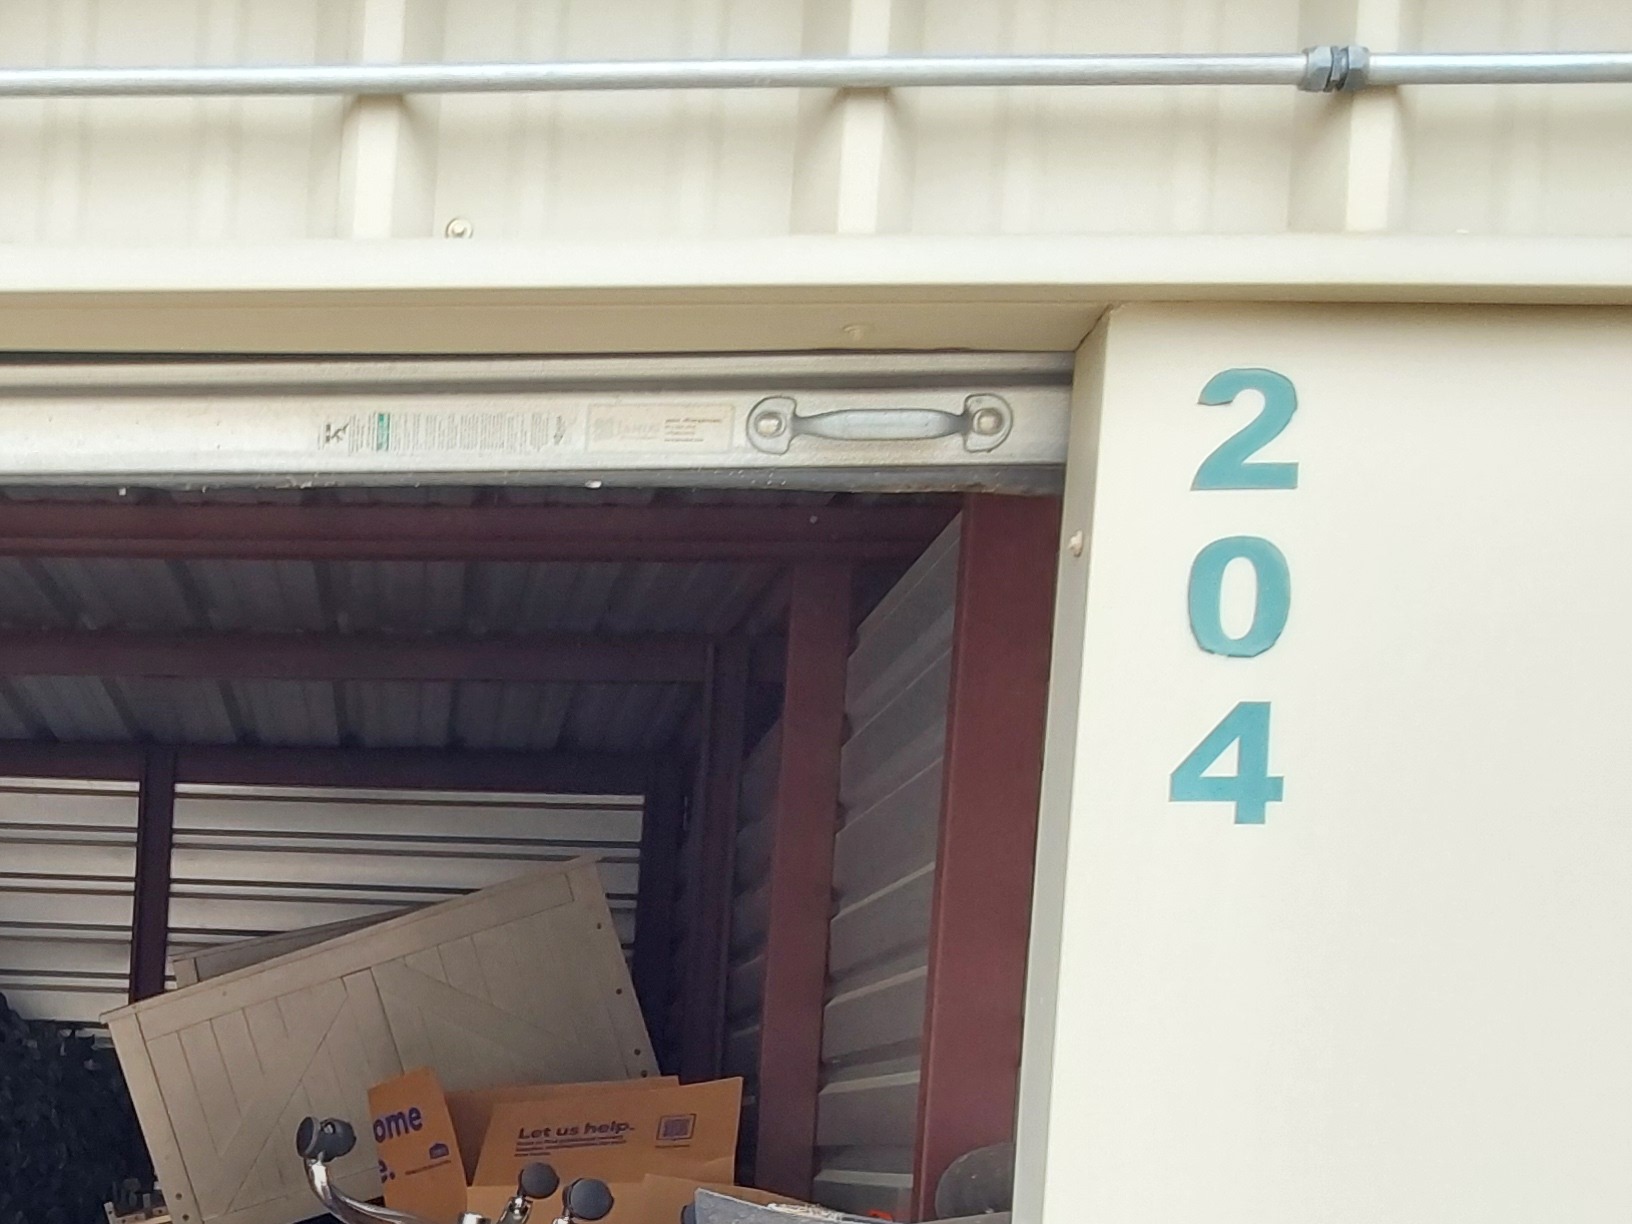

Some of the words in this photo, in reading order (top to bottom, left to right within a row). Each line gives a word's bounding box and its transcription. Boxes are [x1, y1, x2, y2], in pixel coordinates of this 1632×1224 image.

[518, 1127, 550, 1139] Let
[556, 1125, 579, 1136] us
[584, 1119, 635, 1135] help.
